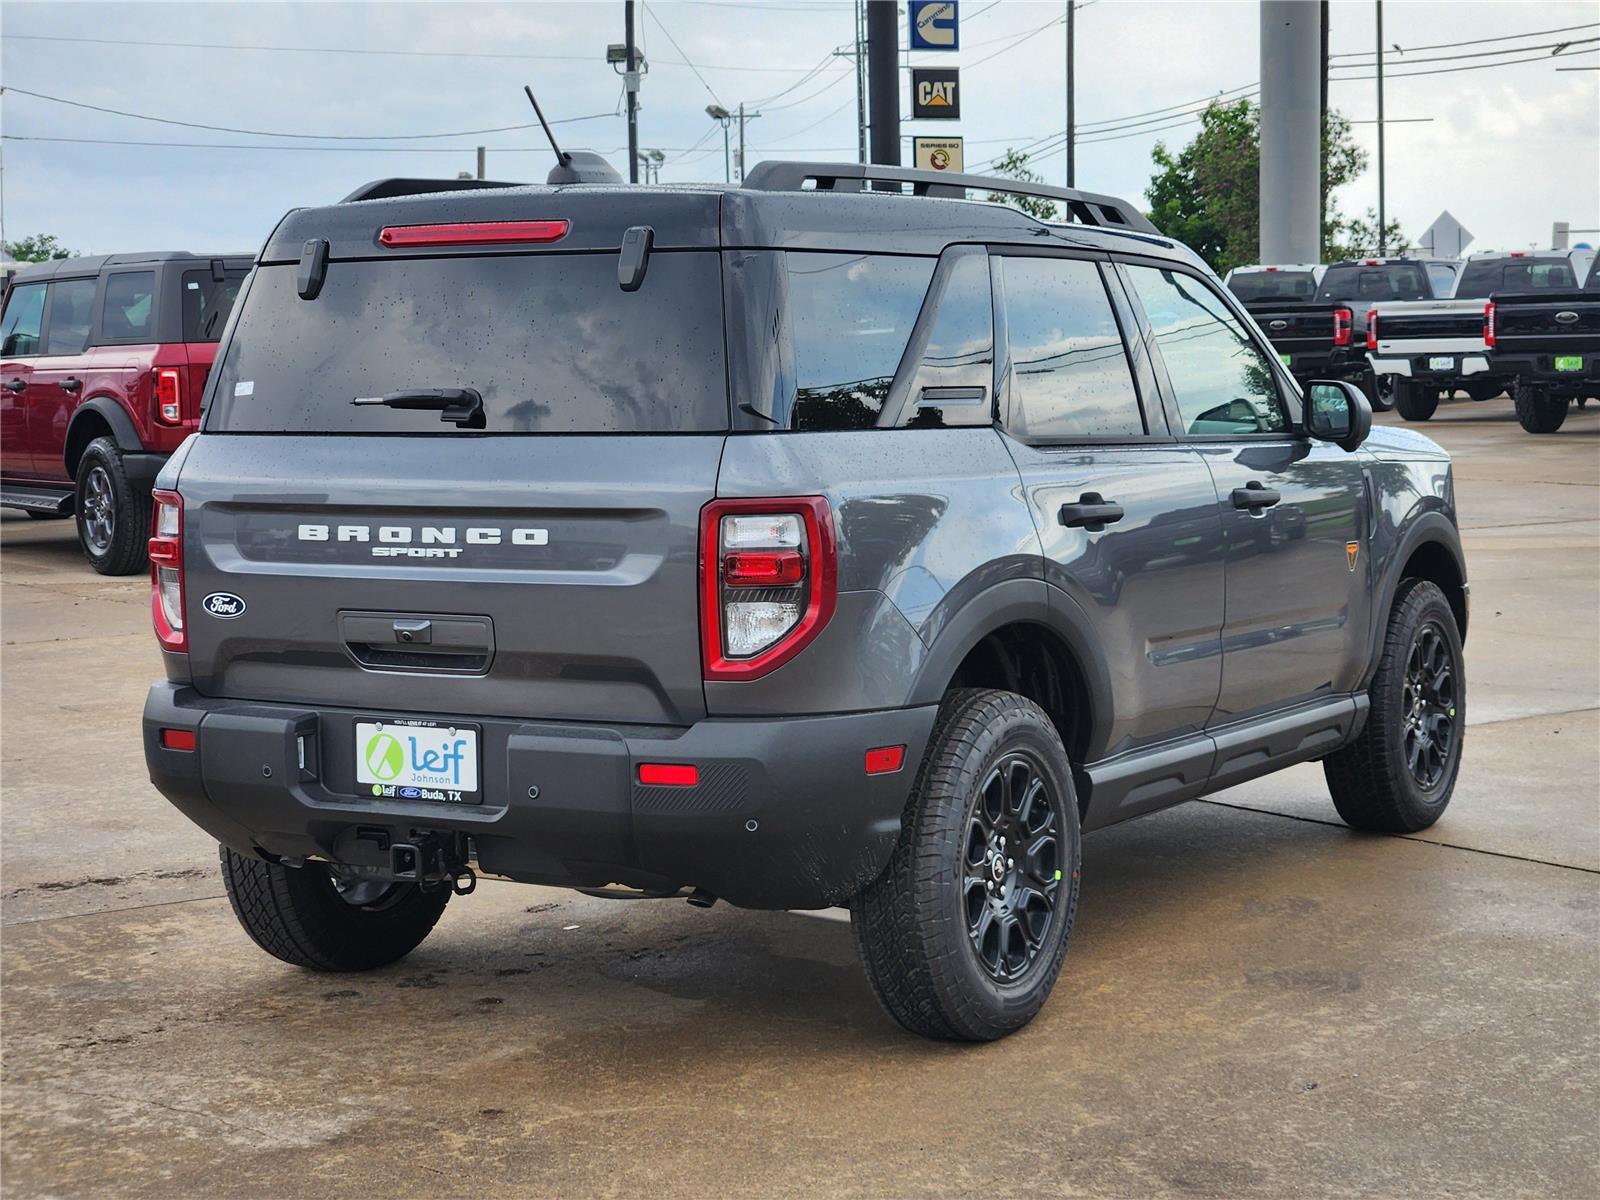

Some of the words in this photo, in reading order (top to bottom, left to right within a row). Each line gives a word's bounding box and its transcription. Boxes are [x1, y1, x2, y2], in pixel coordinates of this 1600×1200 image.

[918, 81, 957, 106] CAT
[298, 524, 549, 546] BRONCO
[371, 546, 464, 558] SPORT
[210, 596, 237, 613] Ford
[408, 736, 467, 785] leif
[411, 773, 451, 785] Johnson
[382, 785, 397, 797] leif
[421, 789, 446, 801] Buda,
[447, 791, 462, 802] TX
